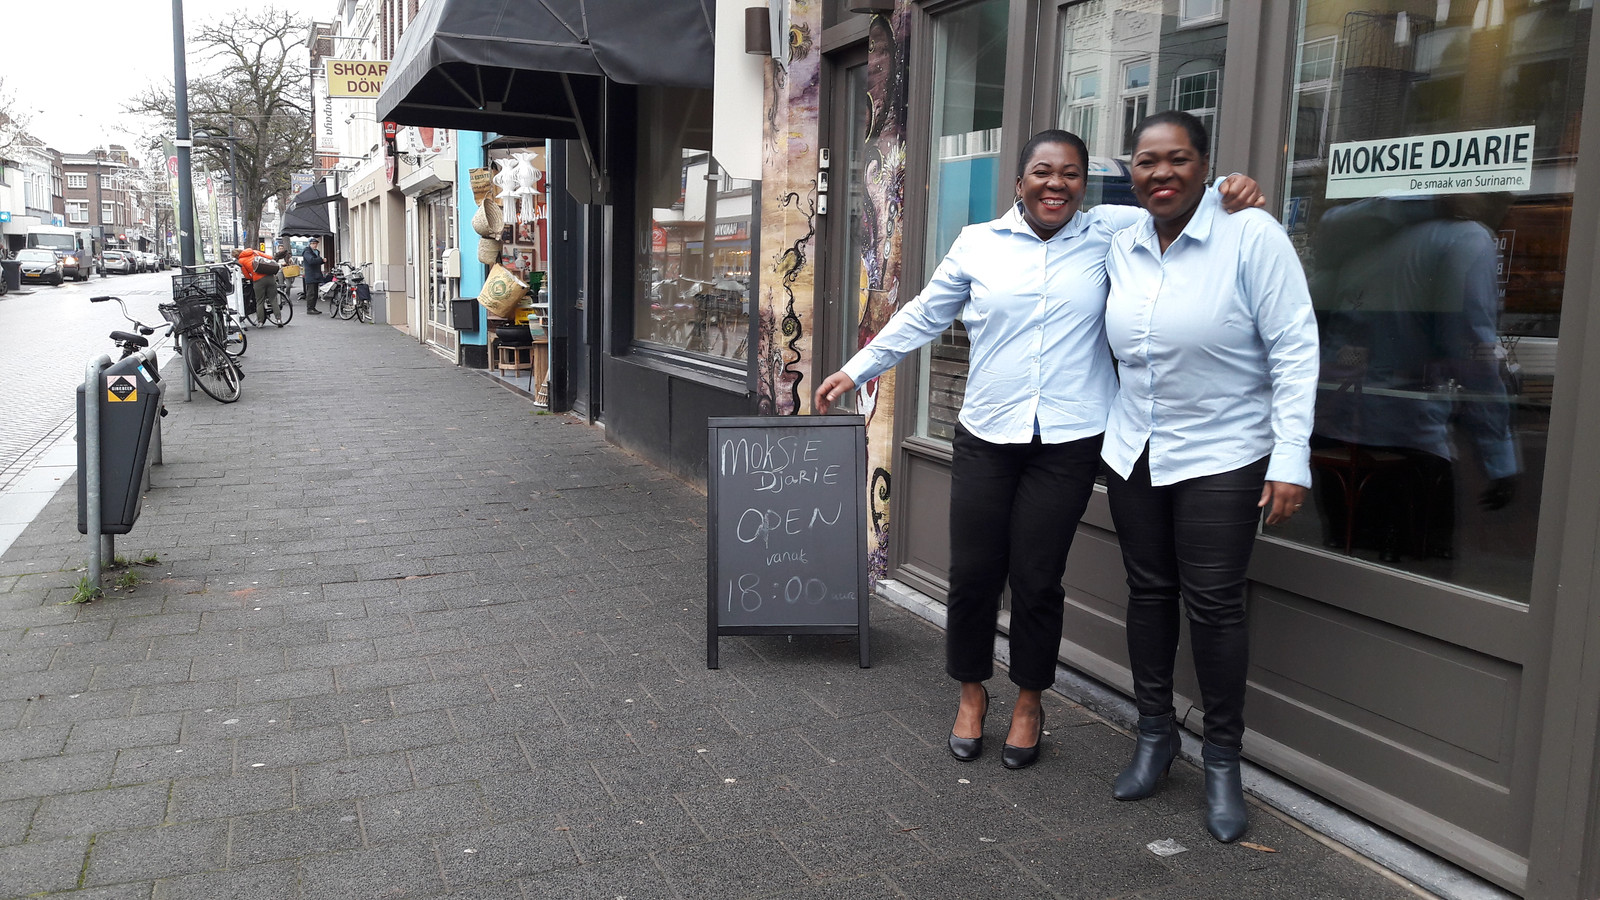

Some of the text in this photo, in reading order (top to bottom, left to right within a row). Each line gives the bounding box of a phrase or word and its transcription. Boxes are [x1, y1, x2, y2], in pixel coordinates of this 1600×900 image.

[347, 77, 383, 93] DÖN
[1330, 132, 1530, 175] MOKSIE DJARIE
[1410, 174, 1525, 190] De smaak van Suriname.
[736, 502, 842, 549] OPEN
